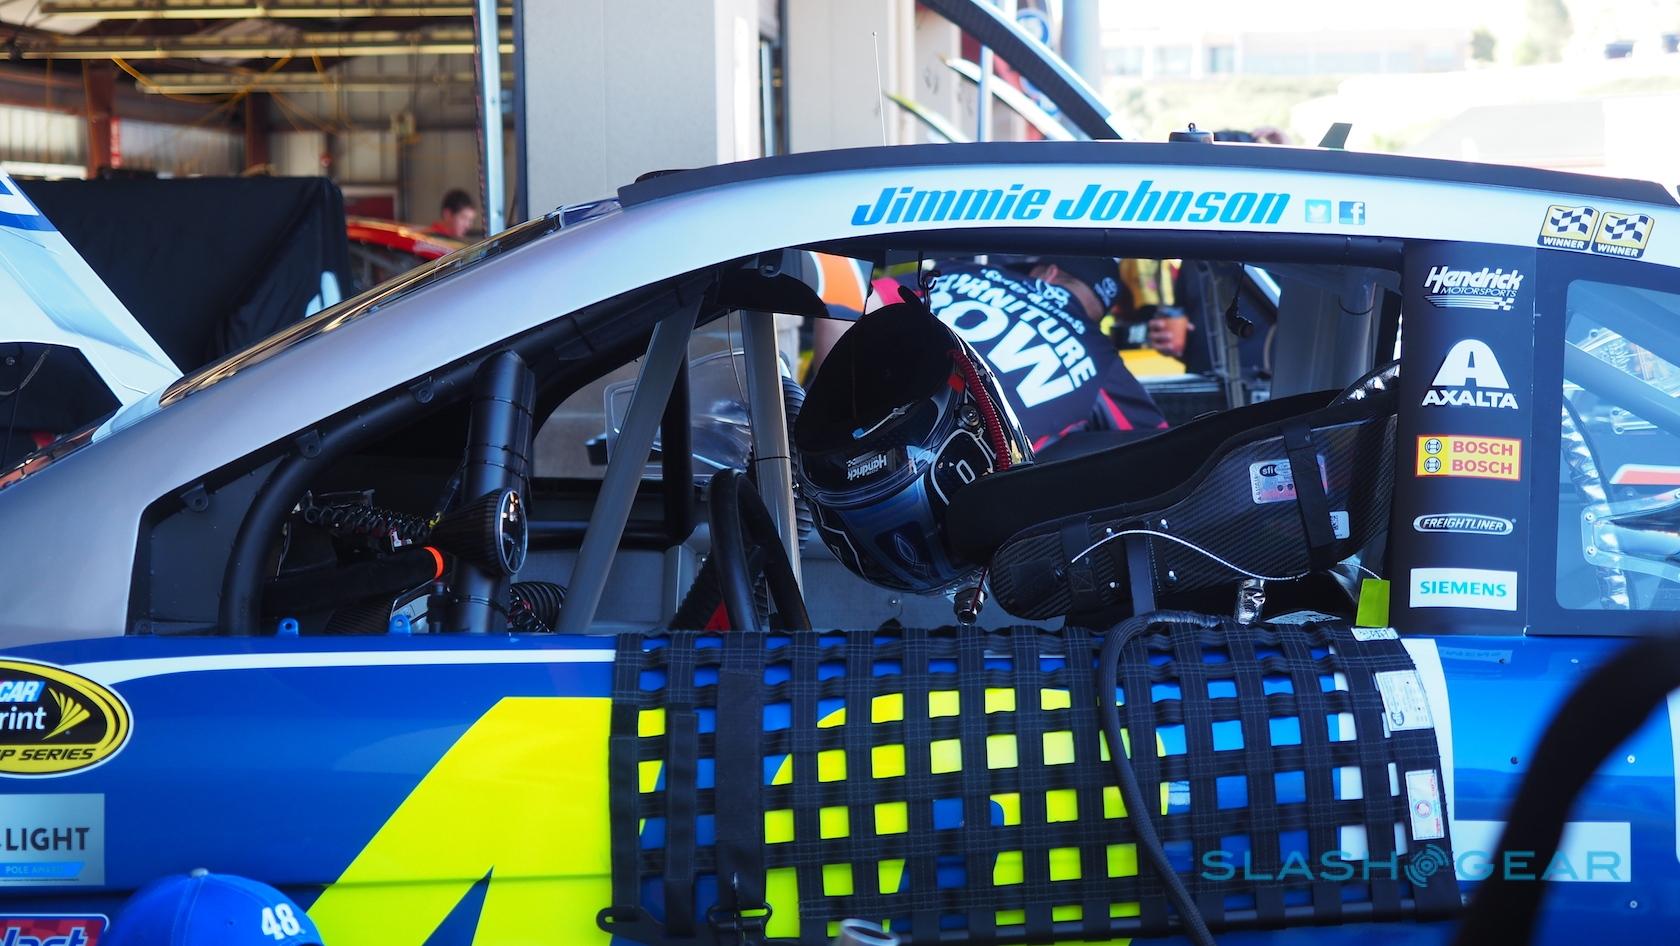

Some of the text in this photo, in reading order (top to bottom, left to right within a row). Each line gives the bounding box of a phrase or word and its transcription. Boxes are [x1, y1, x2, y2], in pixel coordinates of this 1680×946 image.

[851, 183, 1051, 226] Jimmie
[1053, 180, 1291, 225] Johnson
[1543, 236, 1586, 249] WINNER
[1597, 243, 1639, 257] WINNER
[1424, 266, 1524, 293] Hendrick
[1440, 287, 1518, 297] MOTORSPORTS
[1421, 389, 1519, 410] AXALTA
[1452, 440, 1514, 456] BOSCH
[1451, 459, 1513, 475] BOSCH
[1422, 515, 1504, 531] FREIGHTLINER
[1420, 580, 1508, 597] SIEMENS
[18, 748, 96, 761] SERIES
[6, 827, 90, 852] LIGHT
[5, 866, 29, 874] POLE
[261, 902, 302, 941] 48
